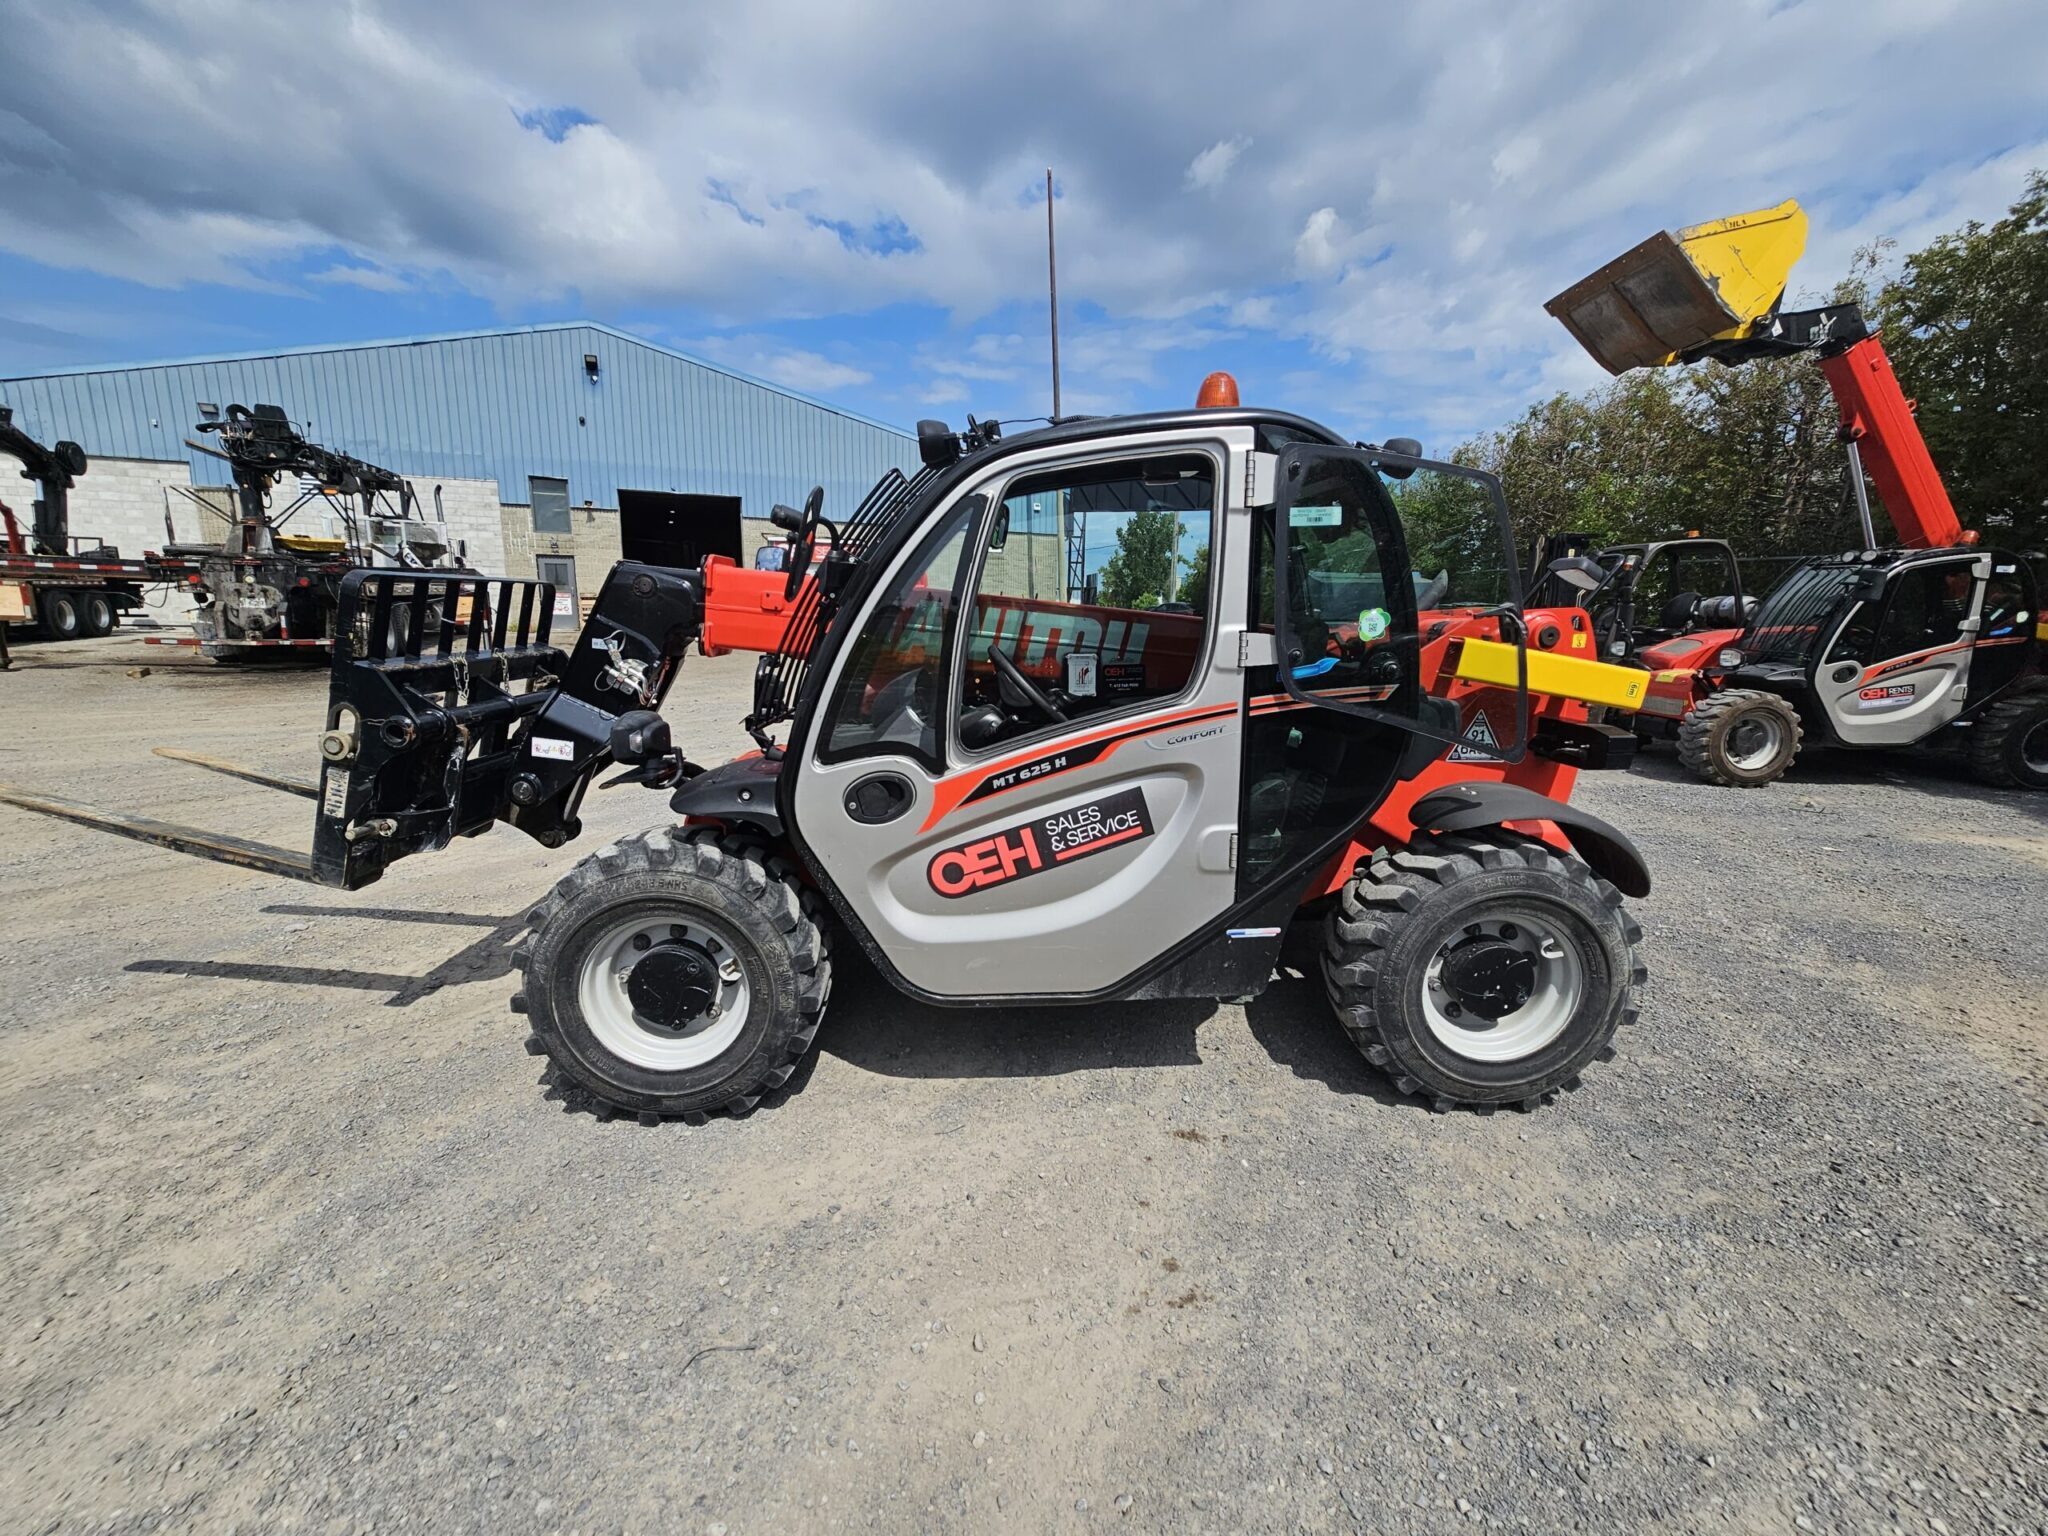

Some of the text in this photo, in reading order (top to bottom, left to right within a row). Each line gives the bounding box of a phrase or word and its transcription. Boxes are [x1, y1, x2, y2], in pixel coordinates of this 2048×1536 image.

[1860, 688, 1888, 700] OEH
[1888, 685, 1913, 695] RENTS
[1471, 729, 1486, 741] 91
[992, 756, 1067, 789] MT 625 H
[1045, 806, 1101, 836] SALES
[1051, 810, 1140, 851] & SERVICE
[930, 827, 1043, 894] OEH
